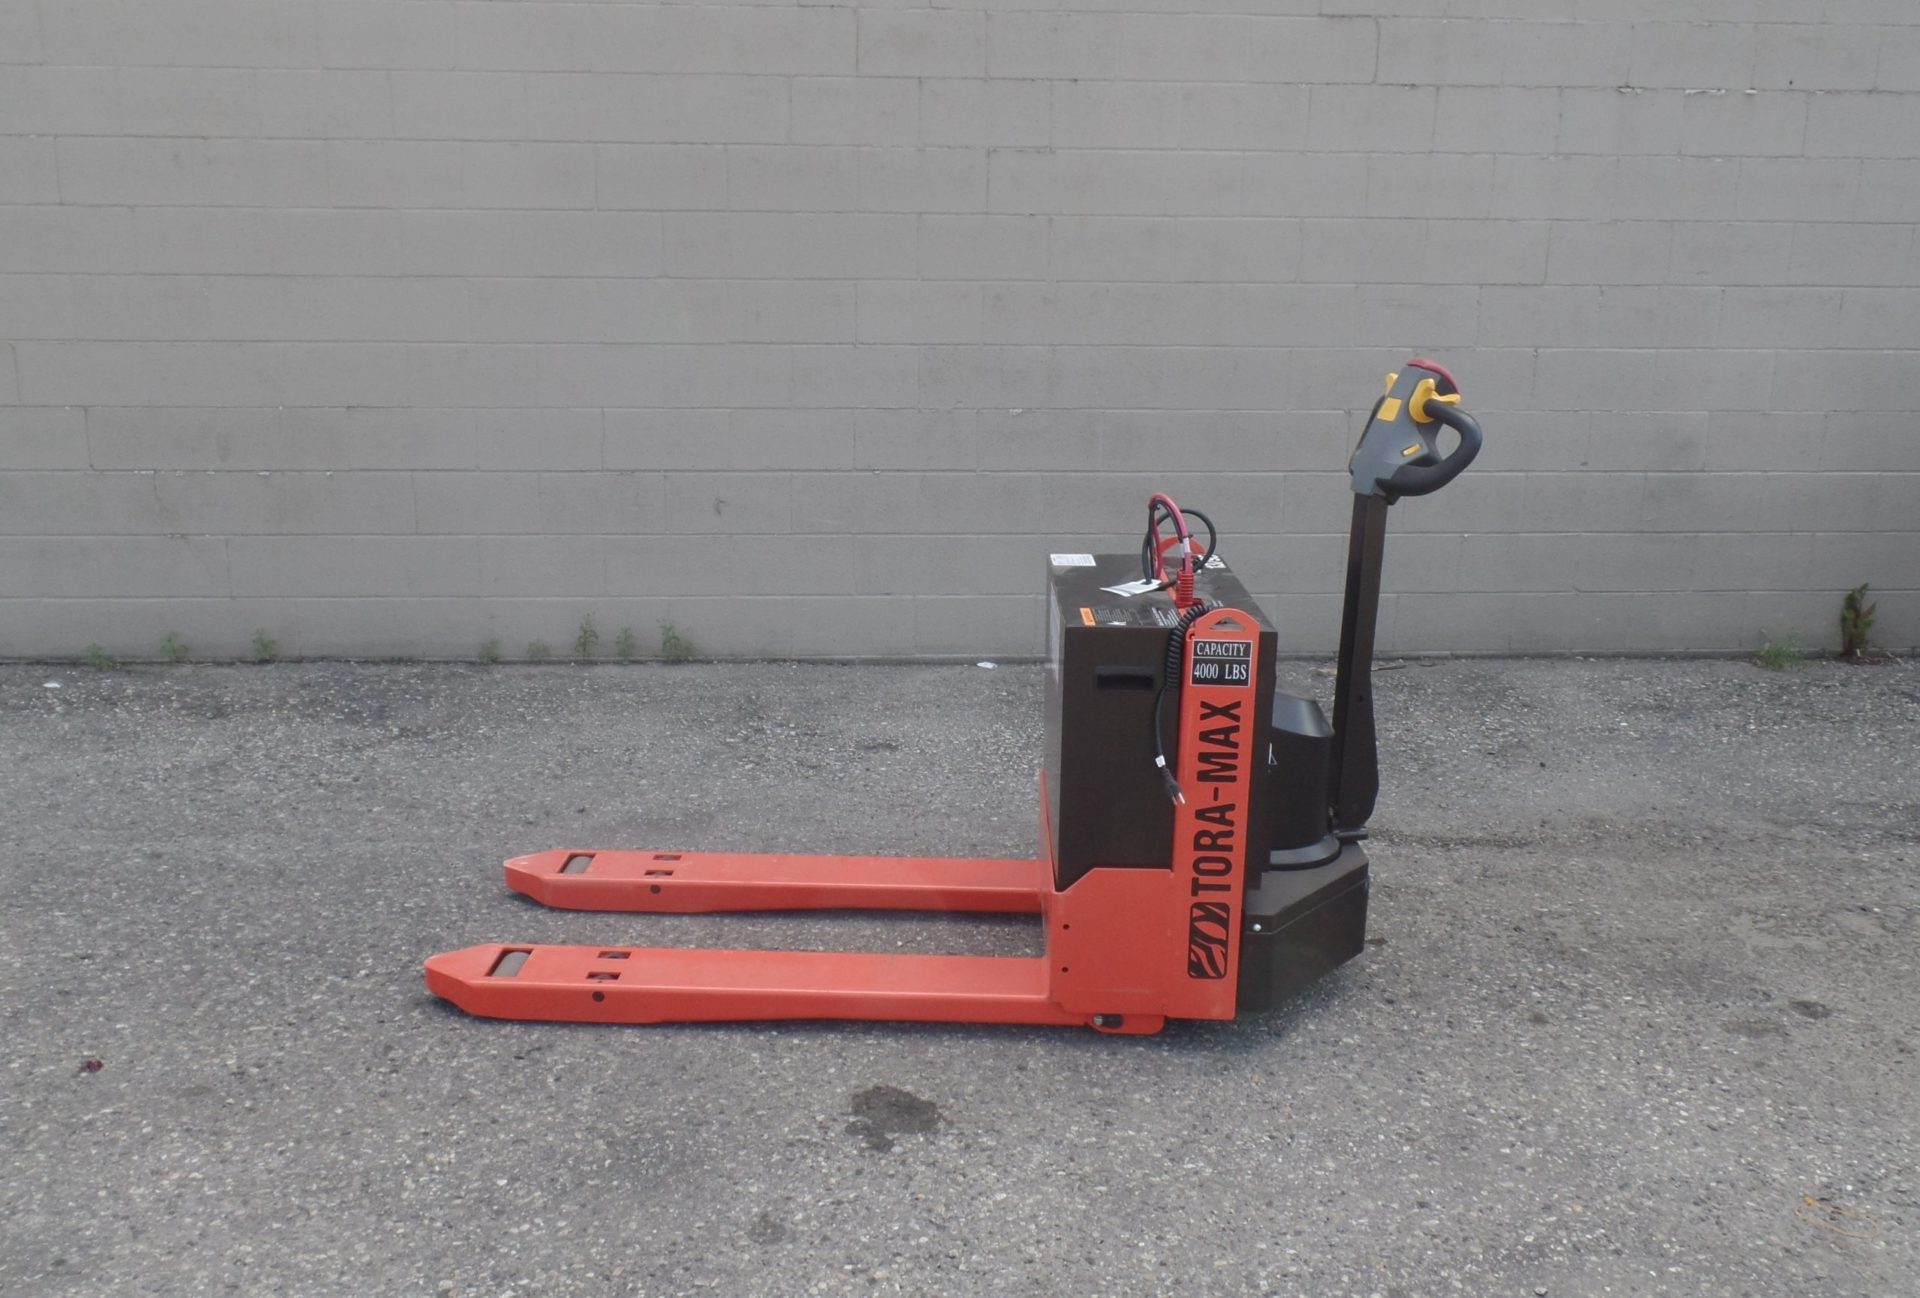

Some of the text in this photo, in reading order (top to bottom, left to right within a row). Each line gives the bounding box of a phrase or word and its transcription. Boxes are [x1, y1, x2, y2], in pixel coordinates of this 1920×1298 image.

[1196, 642, 1246, 656] CAPACITY
[1194, 663, 1247, 680] 4000 LBS
[1192, 700, 1242, 896] TORA-MAX
